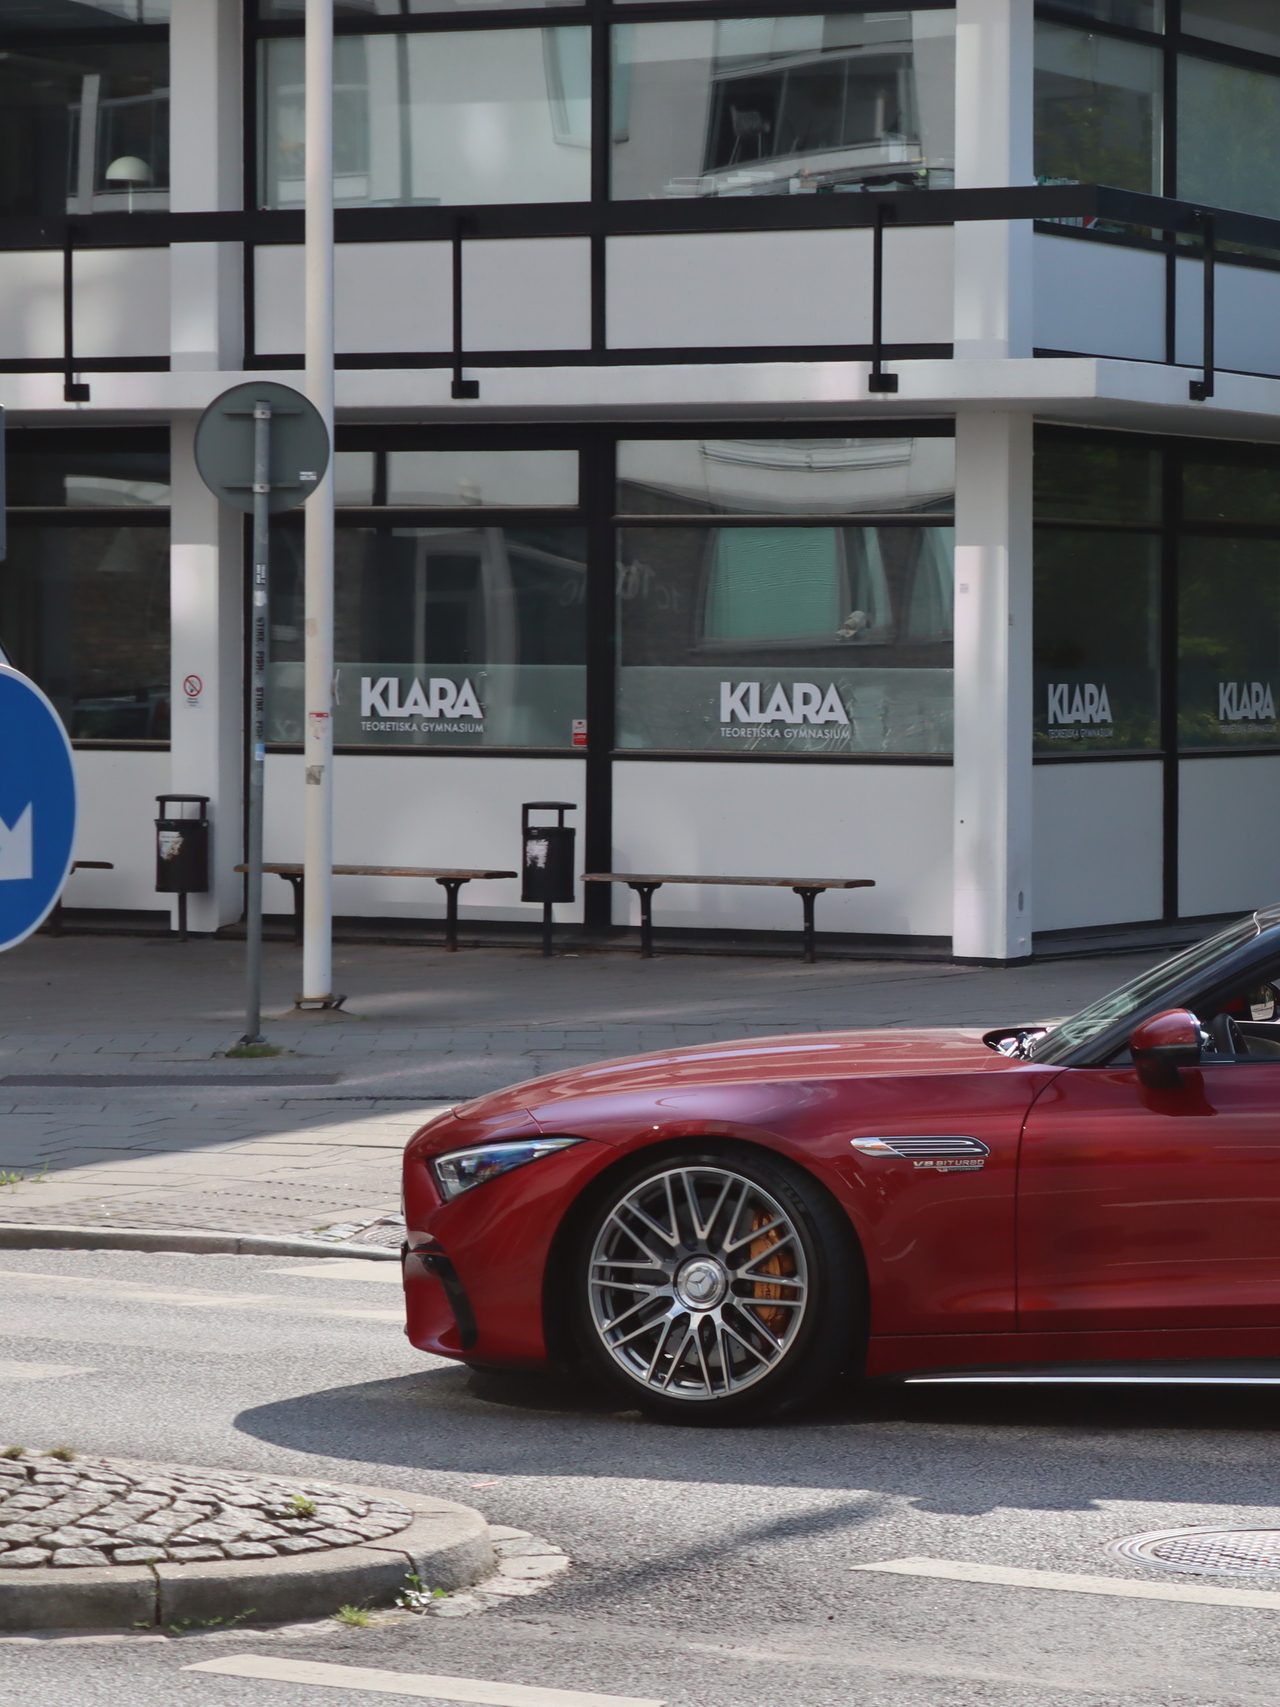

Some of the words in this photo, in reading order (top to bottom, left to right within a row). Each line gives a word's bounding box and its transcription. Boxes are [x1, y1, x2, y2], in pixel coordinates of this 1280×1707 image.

[361, 677, 483, 718] KLARA
[720, 682, 850, 724] KLARA
[1048, 683, 1113, 724] KLARA
[1219, 682, 1276, 720] KLARA
[361, 721, 418, 732] TEORETISKA
[421, 722, 484, 733] GYMNASIUM
[720, 727, 781, 738] TEORETISKA
[784, 728, 850, 739] GYMNASIUM
